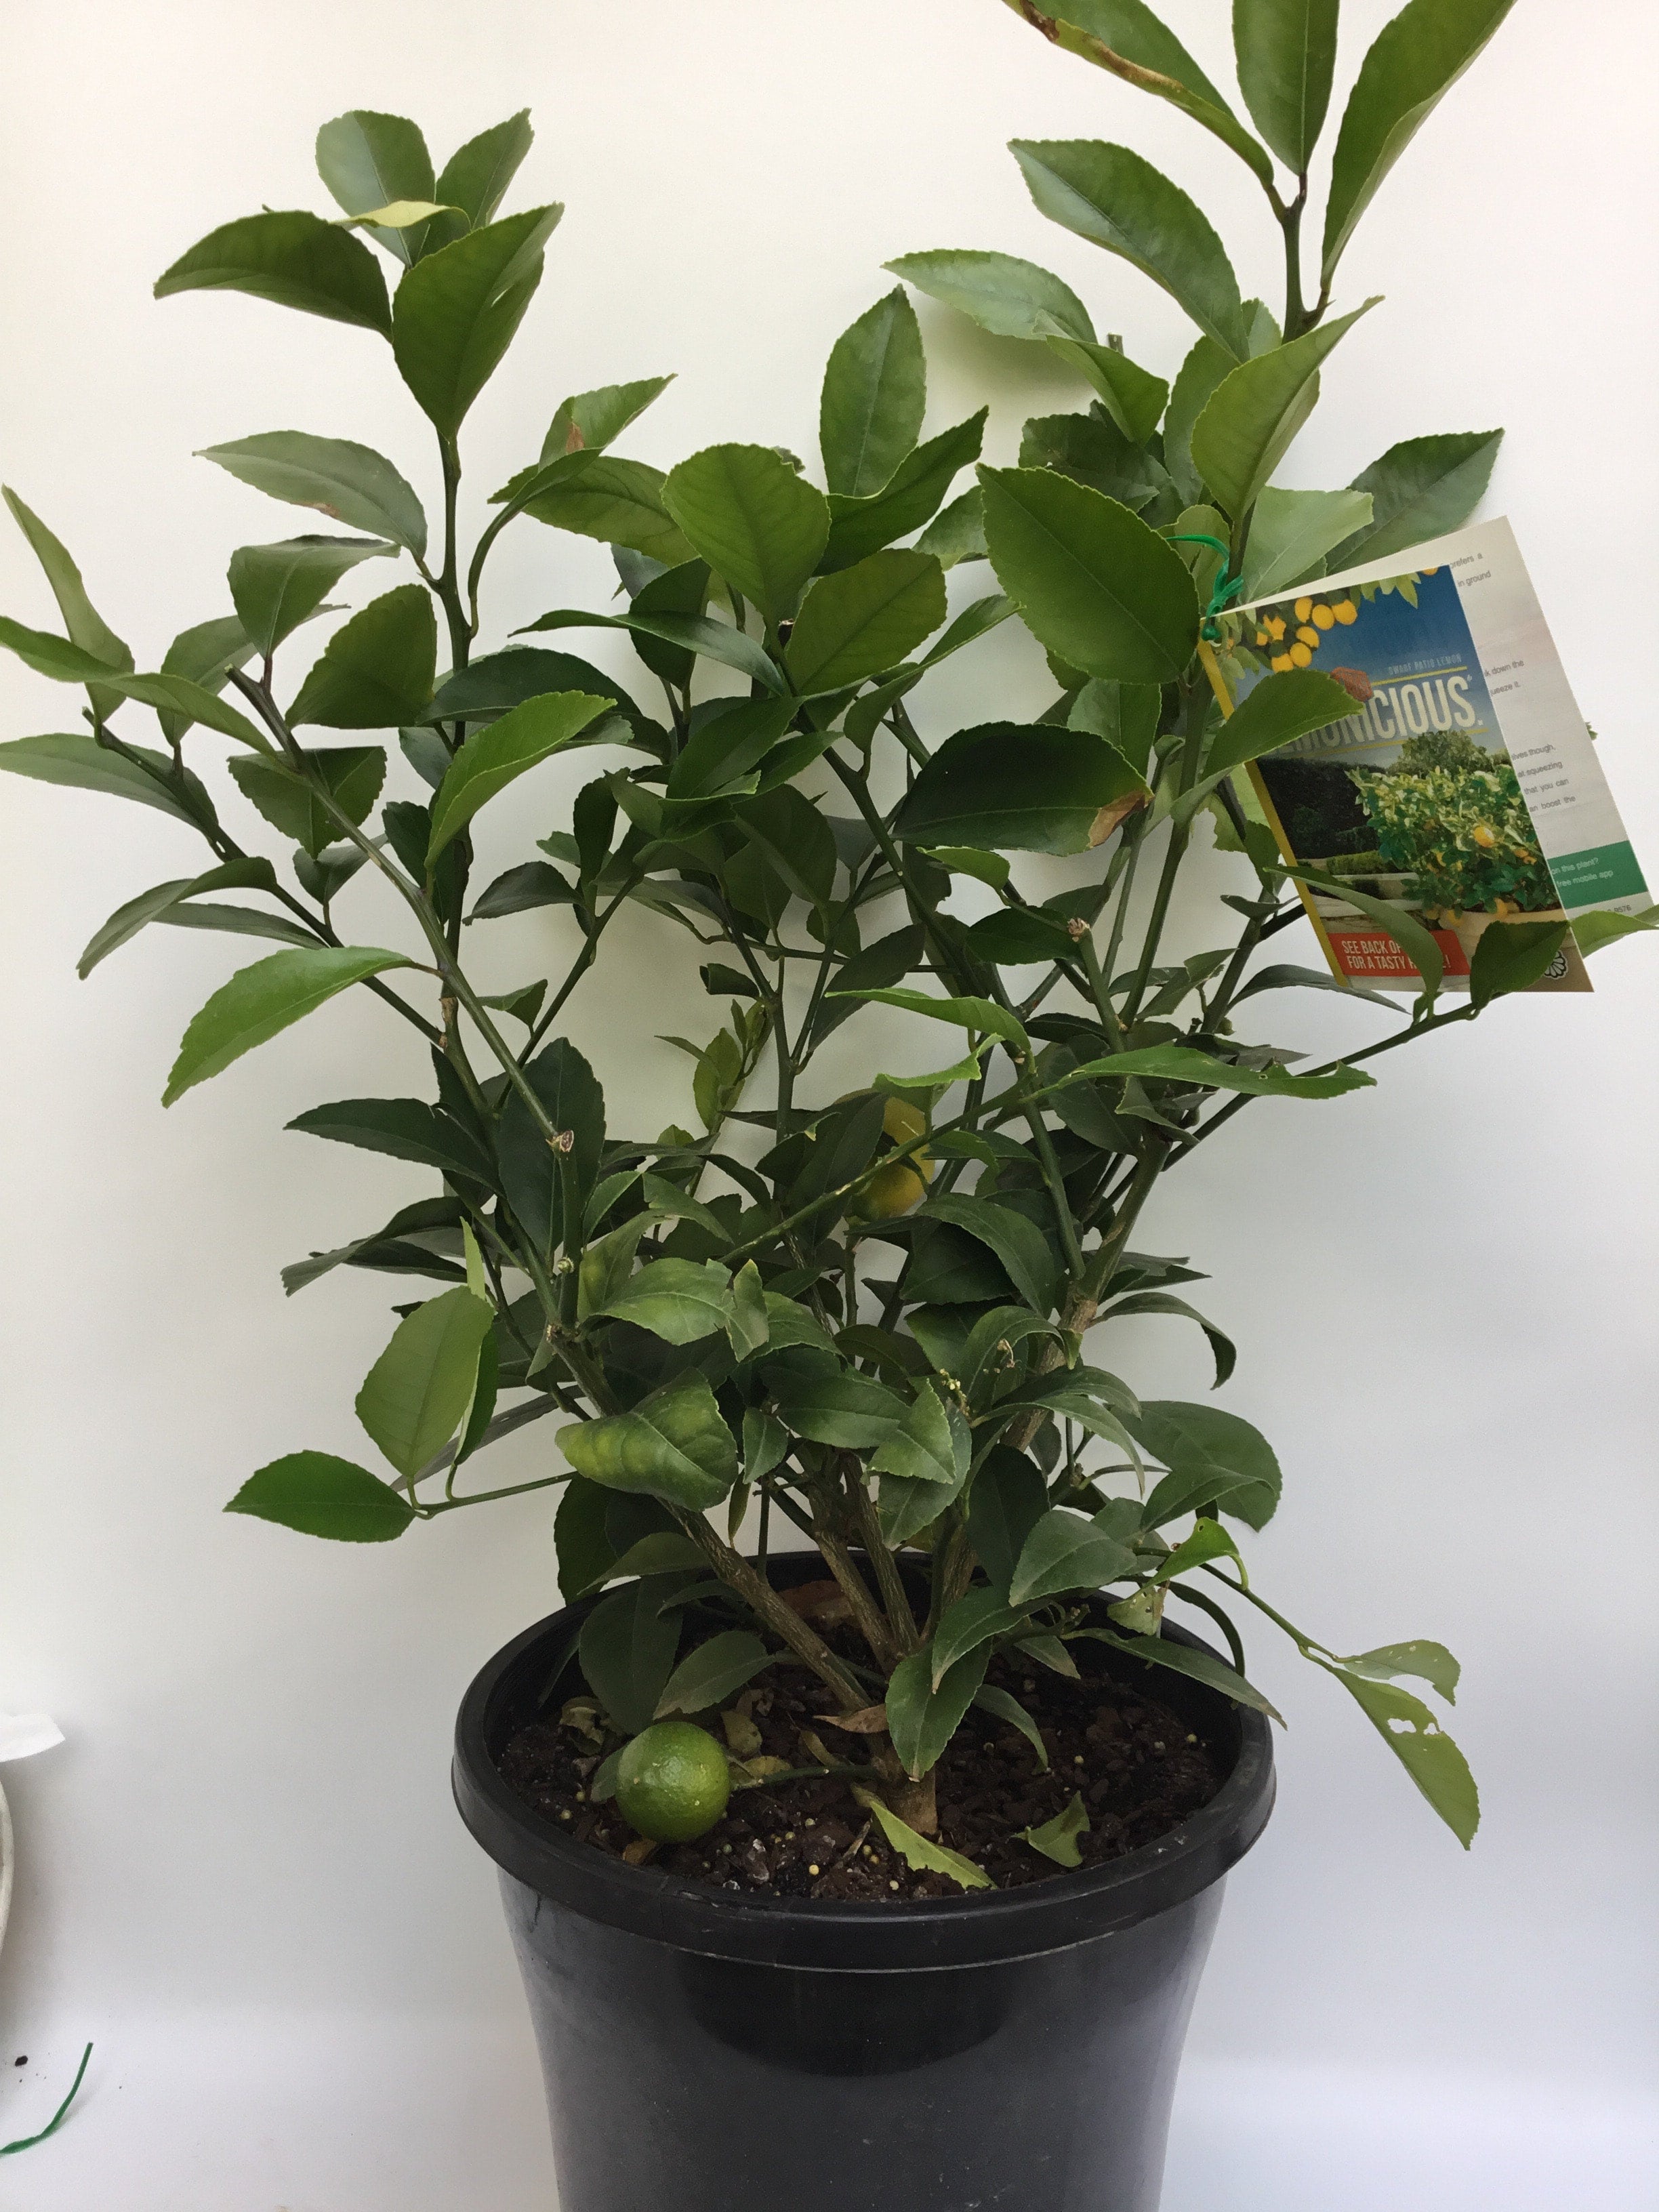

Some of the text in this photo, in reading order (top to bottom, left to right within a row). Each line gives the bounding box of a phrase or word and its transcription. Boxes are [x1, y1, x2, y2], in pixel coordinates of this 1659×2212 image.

[1466, 571, 1491, 586] ground
[1492, 664, 1511, 674] down
[1512, 660, 1524, 668] the
[1526, 761, 1563, 776] squeezing
[1540, 783, 1553, 792] you
[1555, 779, 1569, 787] can
[1540, 799, 1561, 809] boost
[1576, 857, 1599, 870] plant?
[1573, 874, 1597, 884] mobile
[1599, 870, 1613, 879] app
[1342, 941, 1361, 954] SEE
[1360, 940, 1389, 954] BACK
[1347, 956, 1367, 969] FOR
[1368, 956, 1376, 969] A
[1375, 956, 1407, 970] TASTY
